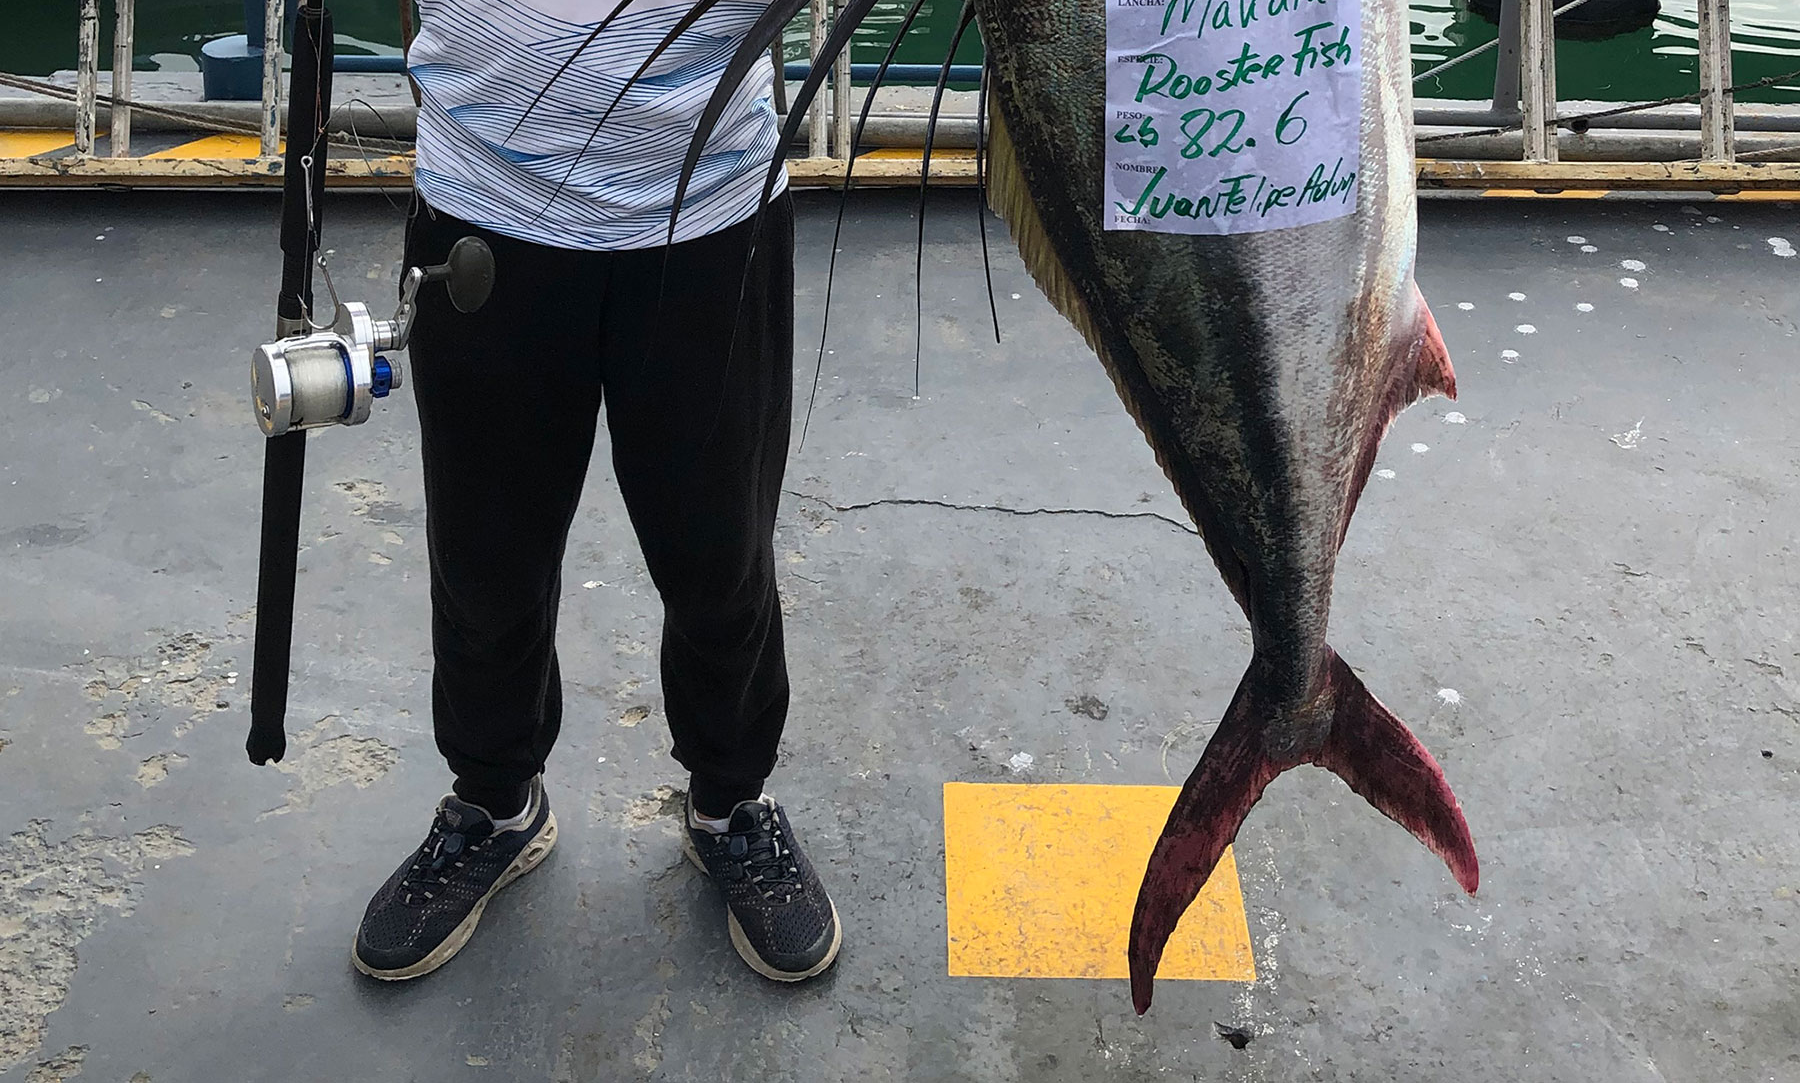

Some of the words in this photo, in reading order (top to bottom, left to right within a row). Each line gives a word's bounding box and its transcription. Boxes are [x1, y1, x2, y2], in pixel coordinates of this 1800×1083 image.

[1292, 21, 1351, 77] Fish
[1116, 110, 1146, 120] PESO:
[1114, 215, 1151, 225] FECHA:
